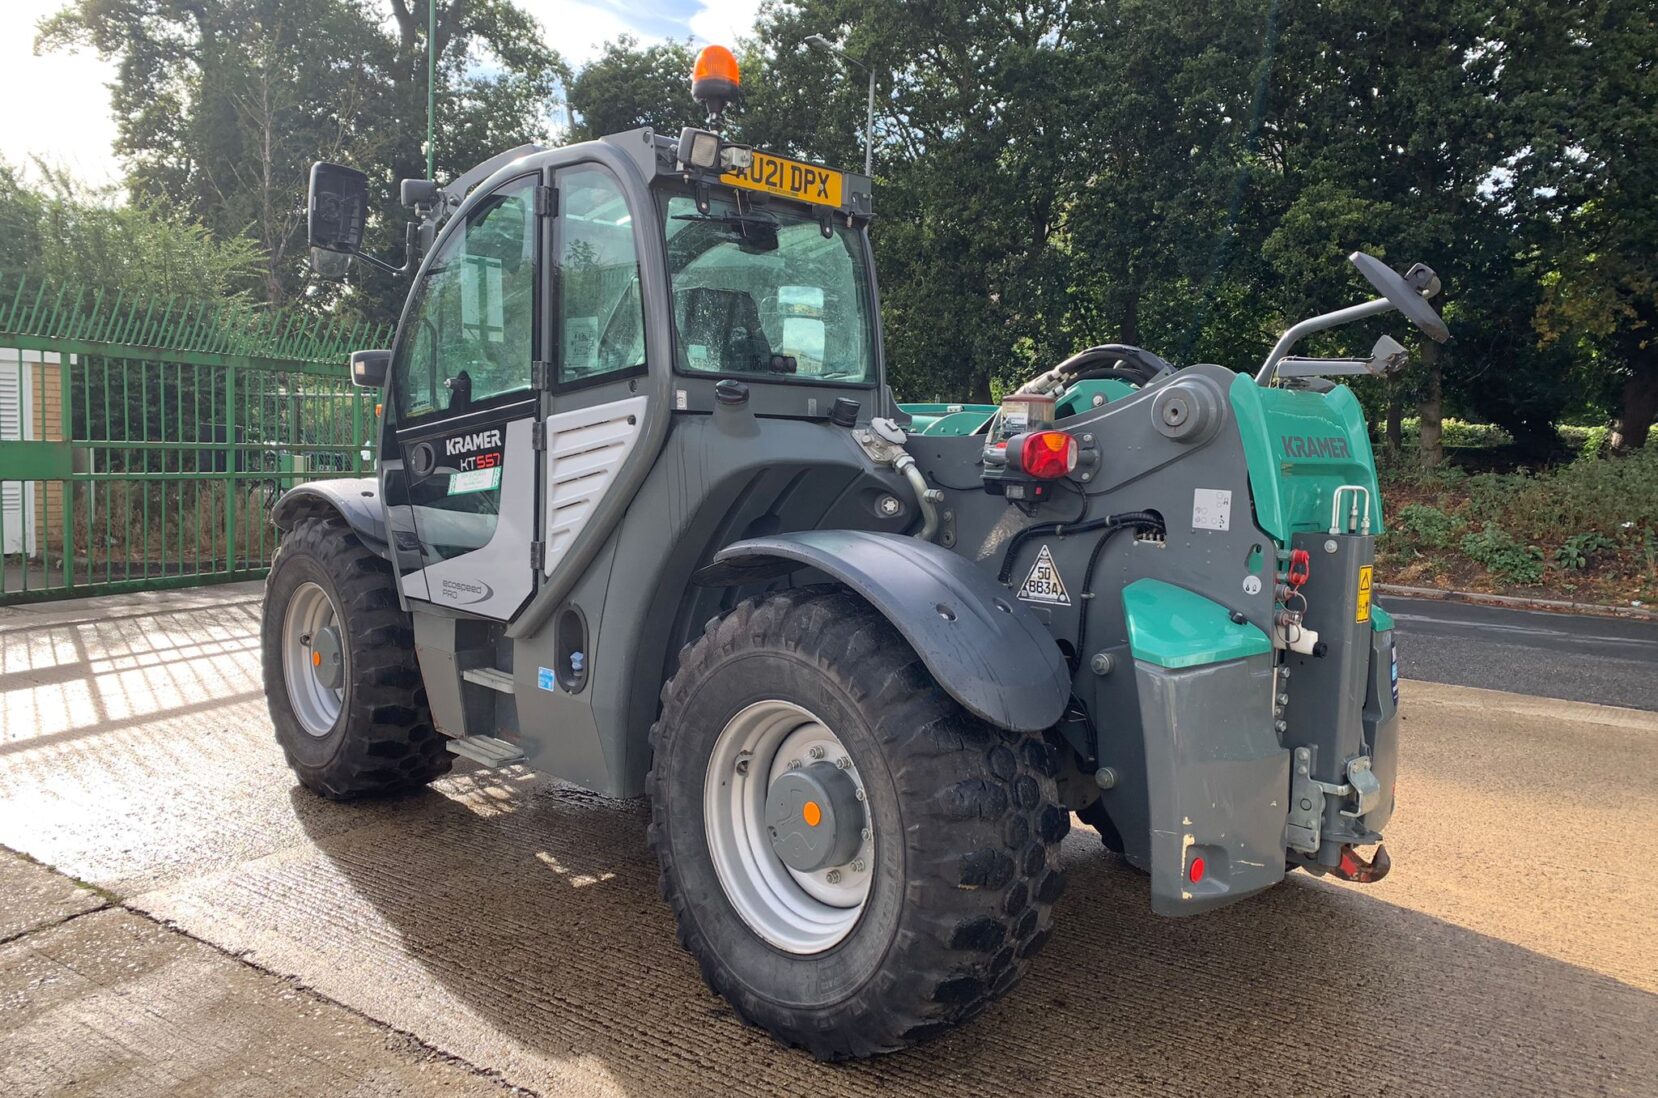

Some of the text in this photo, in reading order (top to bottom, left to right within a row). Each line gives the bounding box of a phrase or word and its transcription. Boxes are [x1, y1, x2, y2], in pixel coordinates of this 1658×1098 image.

[789, 164, 830, 199] DPX
[446, 429, 502, 456] KRAMER
[1281, 435, 1352, 459] KRAMER
[460, 452, 501, 472] KT557
[442, 589, 458, 600] PRO
